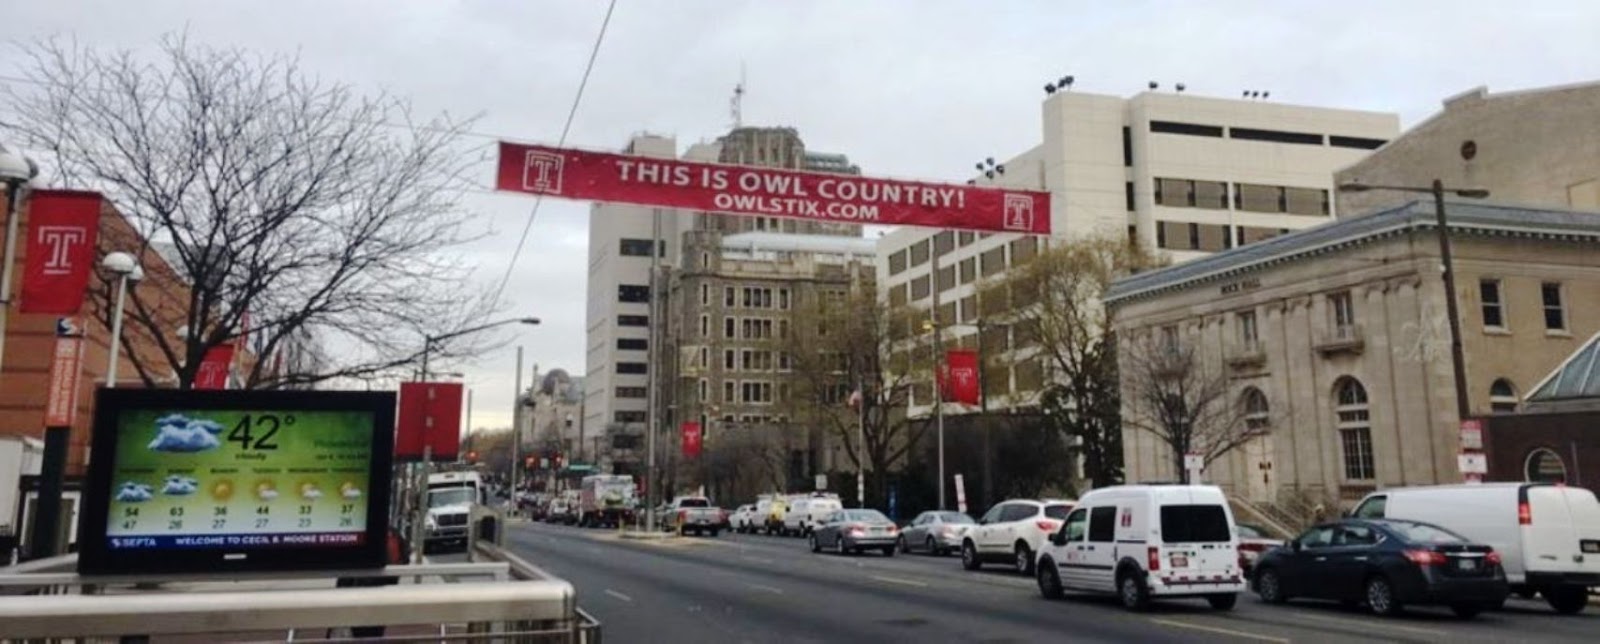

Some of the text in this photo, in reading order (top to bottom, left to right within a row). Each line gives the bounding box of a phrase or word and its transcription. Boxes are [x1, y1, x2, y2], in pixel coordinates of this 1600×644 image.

[616, 160, 965, 209] THIS IS OWL COUNTRY!
[714, 193, 880, 221] OWLSTIX.COM
[38, 226, 86, 274] T
[227, 413, 296, 450] 42°
[125, 506, 140, 517] 54
[256, 505, 270, 515] 44
[122, 538, 157, 547] SEPTA
[175, 537, 225, 546] WELCOME
[228, 536, 240, 544] TO
[241, 535, 270, 545] CECIL
[283, 534, 317, 543] MOORE
[319, 533, 359, 543] STATION
